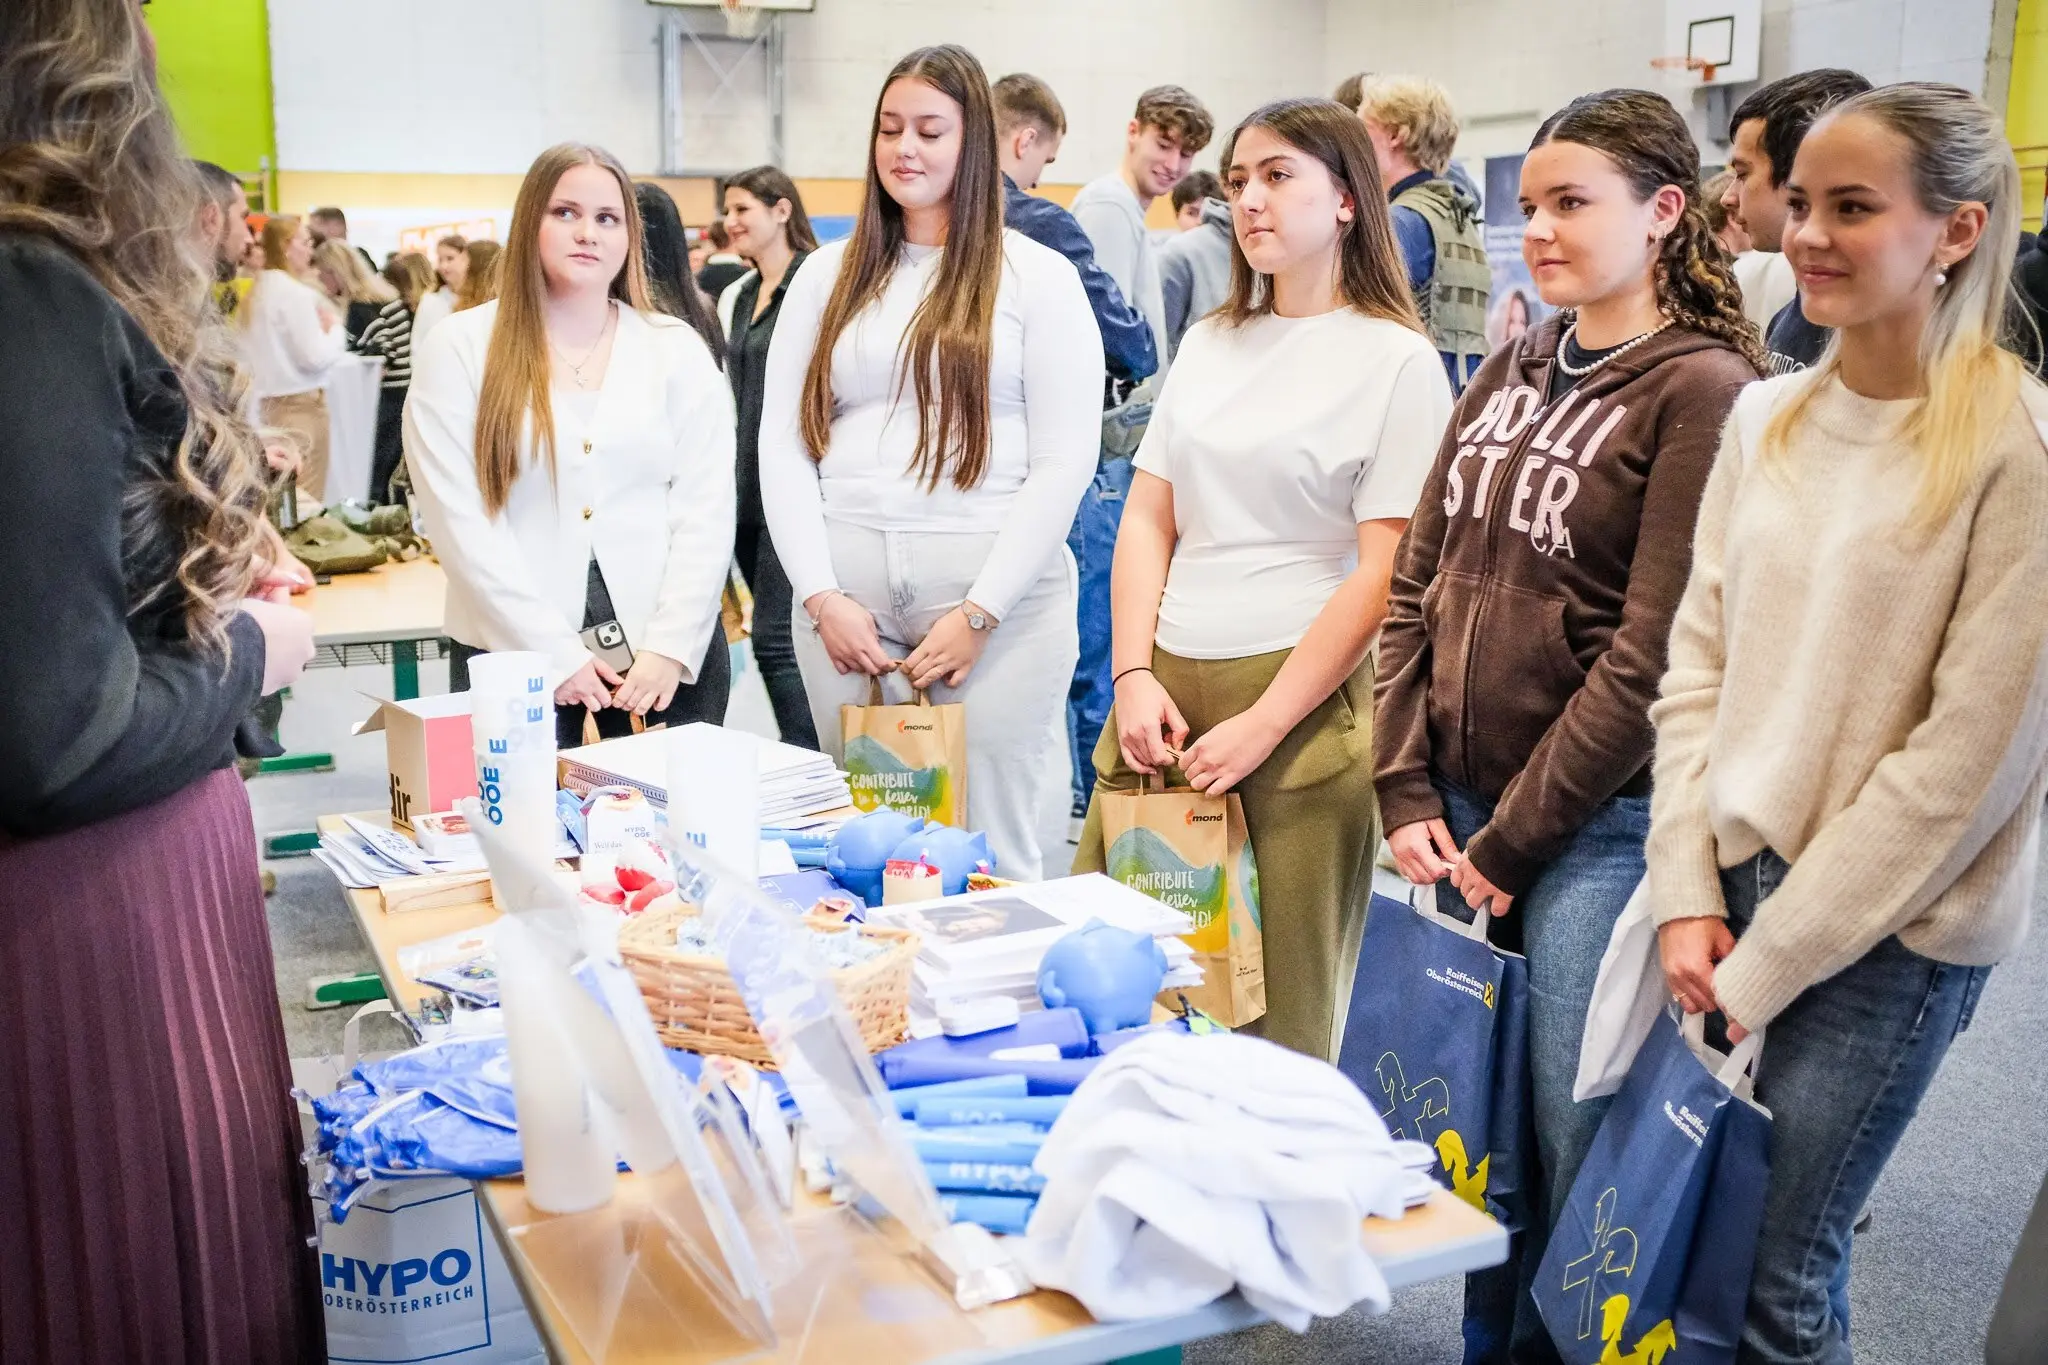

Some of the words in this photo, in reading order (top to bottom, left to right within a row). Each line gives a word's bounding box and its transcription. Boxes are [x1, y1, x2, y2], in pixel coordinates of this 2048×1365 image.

[851, 772, 915, 789] CONTRIBUTE
[1192, 813, 1223, 822] mond
[1126, 870, 1195, 891] CONTRIBUTE
[1160, 891, 1199, 909] better
[1426, 968, 1483, 1001] Oberösterreich
[1446, 967, 1484, 991] Raiffeisen
[1679, 1106, 1709, 1137] Raiffei
[322, 1249, 471, 1297] HYPO
[324, 1285, 474, 1315] OBERÖSTERREICH
